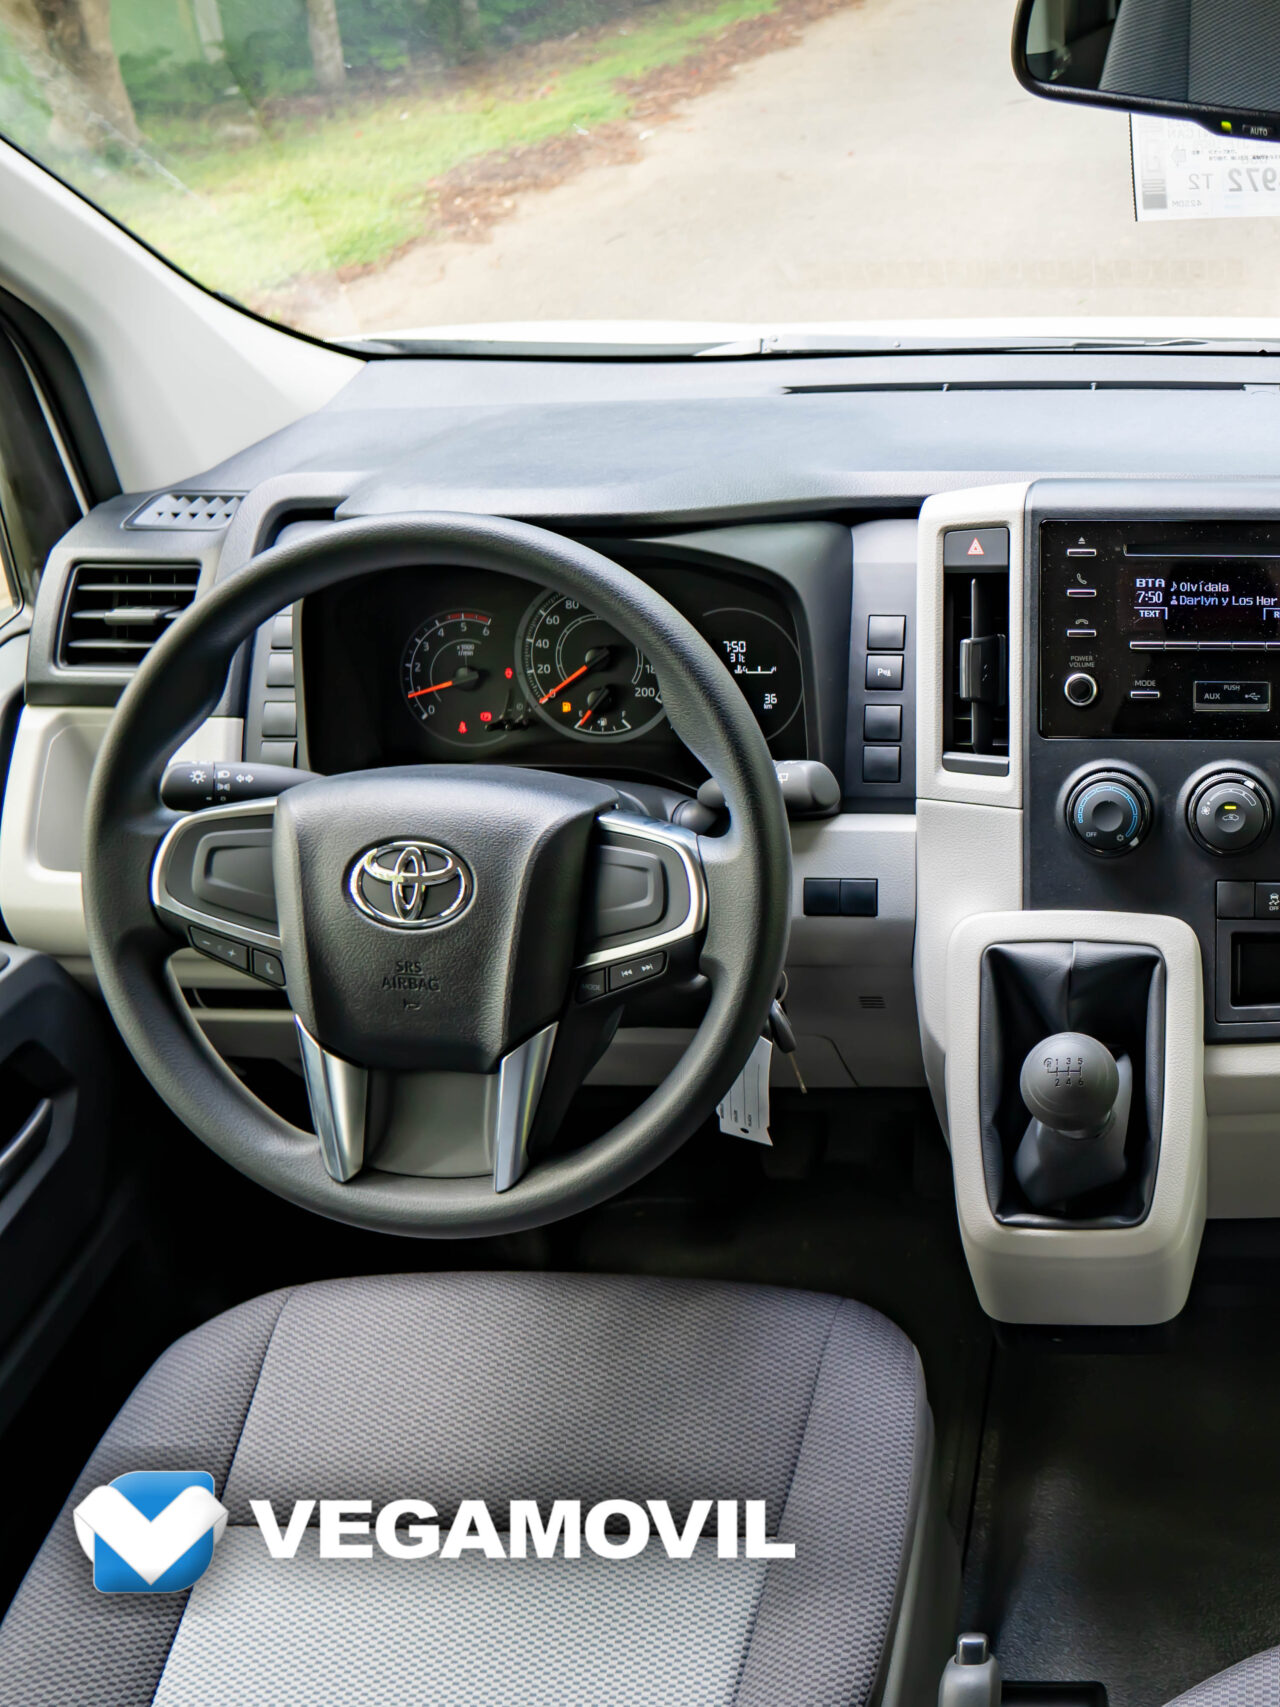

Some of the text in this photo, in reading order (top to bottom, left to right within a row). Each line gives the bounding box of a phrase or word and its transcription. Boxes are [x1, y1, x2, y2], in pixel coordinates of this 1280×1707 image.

[1250, 127, 1269, 137] AUTO
[1135, 578, 1165, 588] BTA
[1179, 580, 1230, 592] Olvídala
[1135, 590, 1163, 604] 7:50
[1179, 595, 1278, 607] Darlyn y Los Her
[565, 600, 580, 610] 80
[1139, 610, 1161, 618] TEXT
[545, 615, 560, 625] 60
[460, 622, 467, 632] 5
[482, 626, 490, 637] 6
[437, 628, 445, 637] 4
[422, 641, 430, 652] 3
[535, 638, 549, 648] 40
[722, 640, 747, 653] 7:50
[414, 662, 421, 672] 2
[537, 664, 551, 674] 20
[1134, 679, 1157, 687] MODE
[634, 687, 656, 698] 200
[1203, 692, 1221, 700] AUX
[764, 693, 778, 704] 36
[427, 704, 435, 715] 0
[396, 960, 422, 973] SRS
[382, 975, 440, 991] AIRBAG
